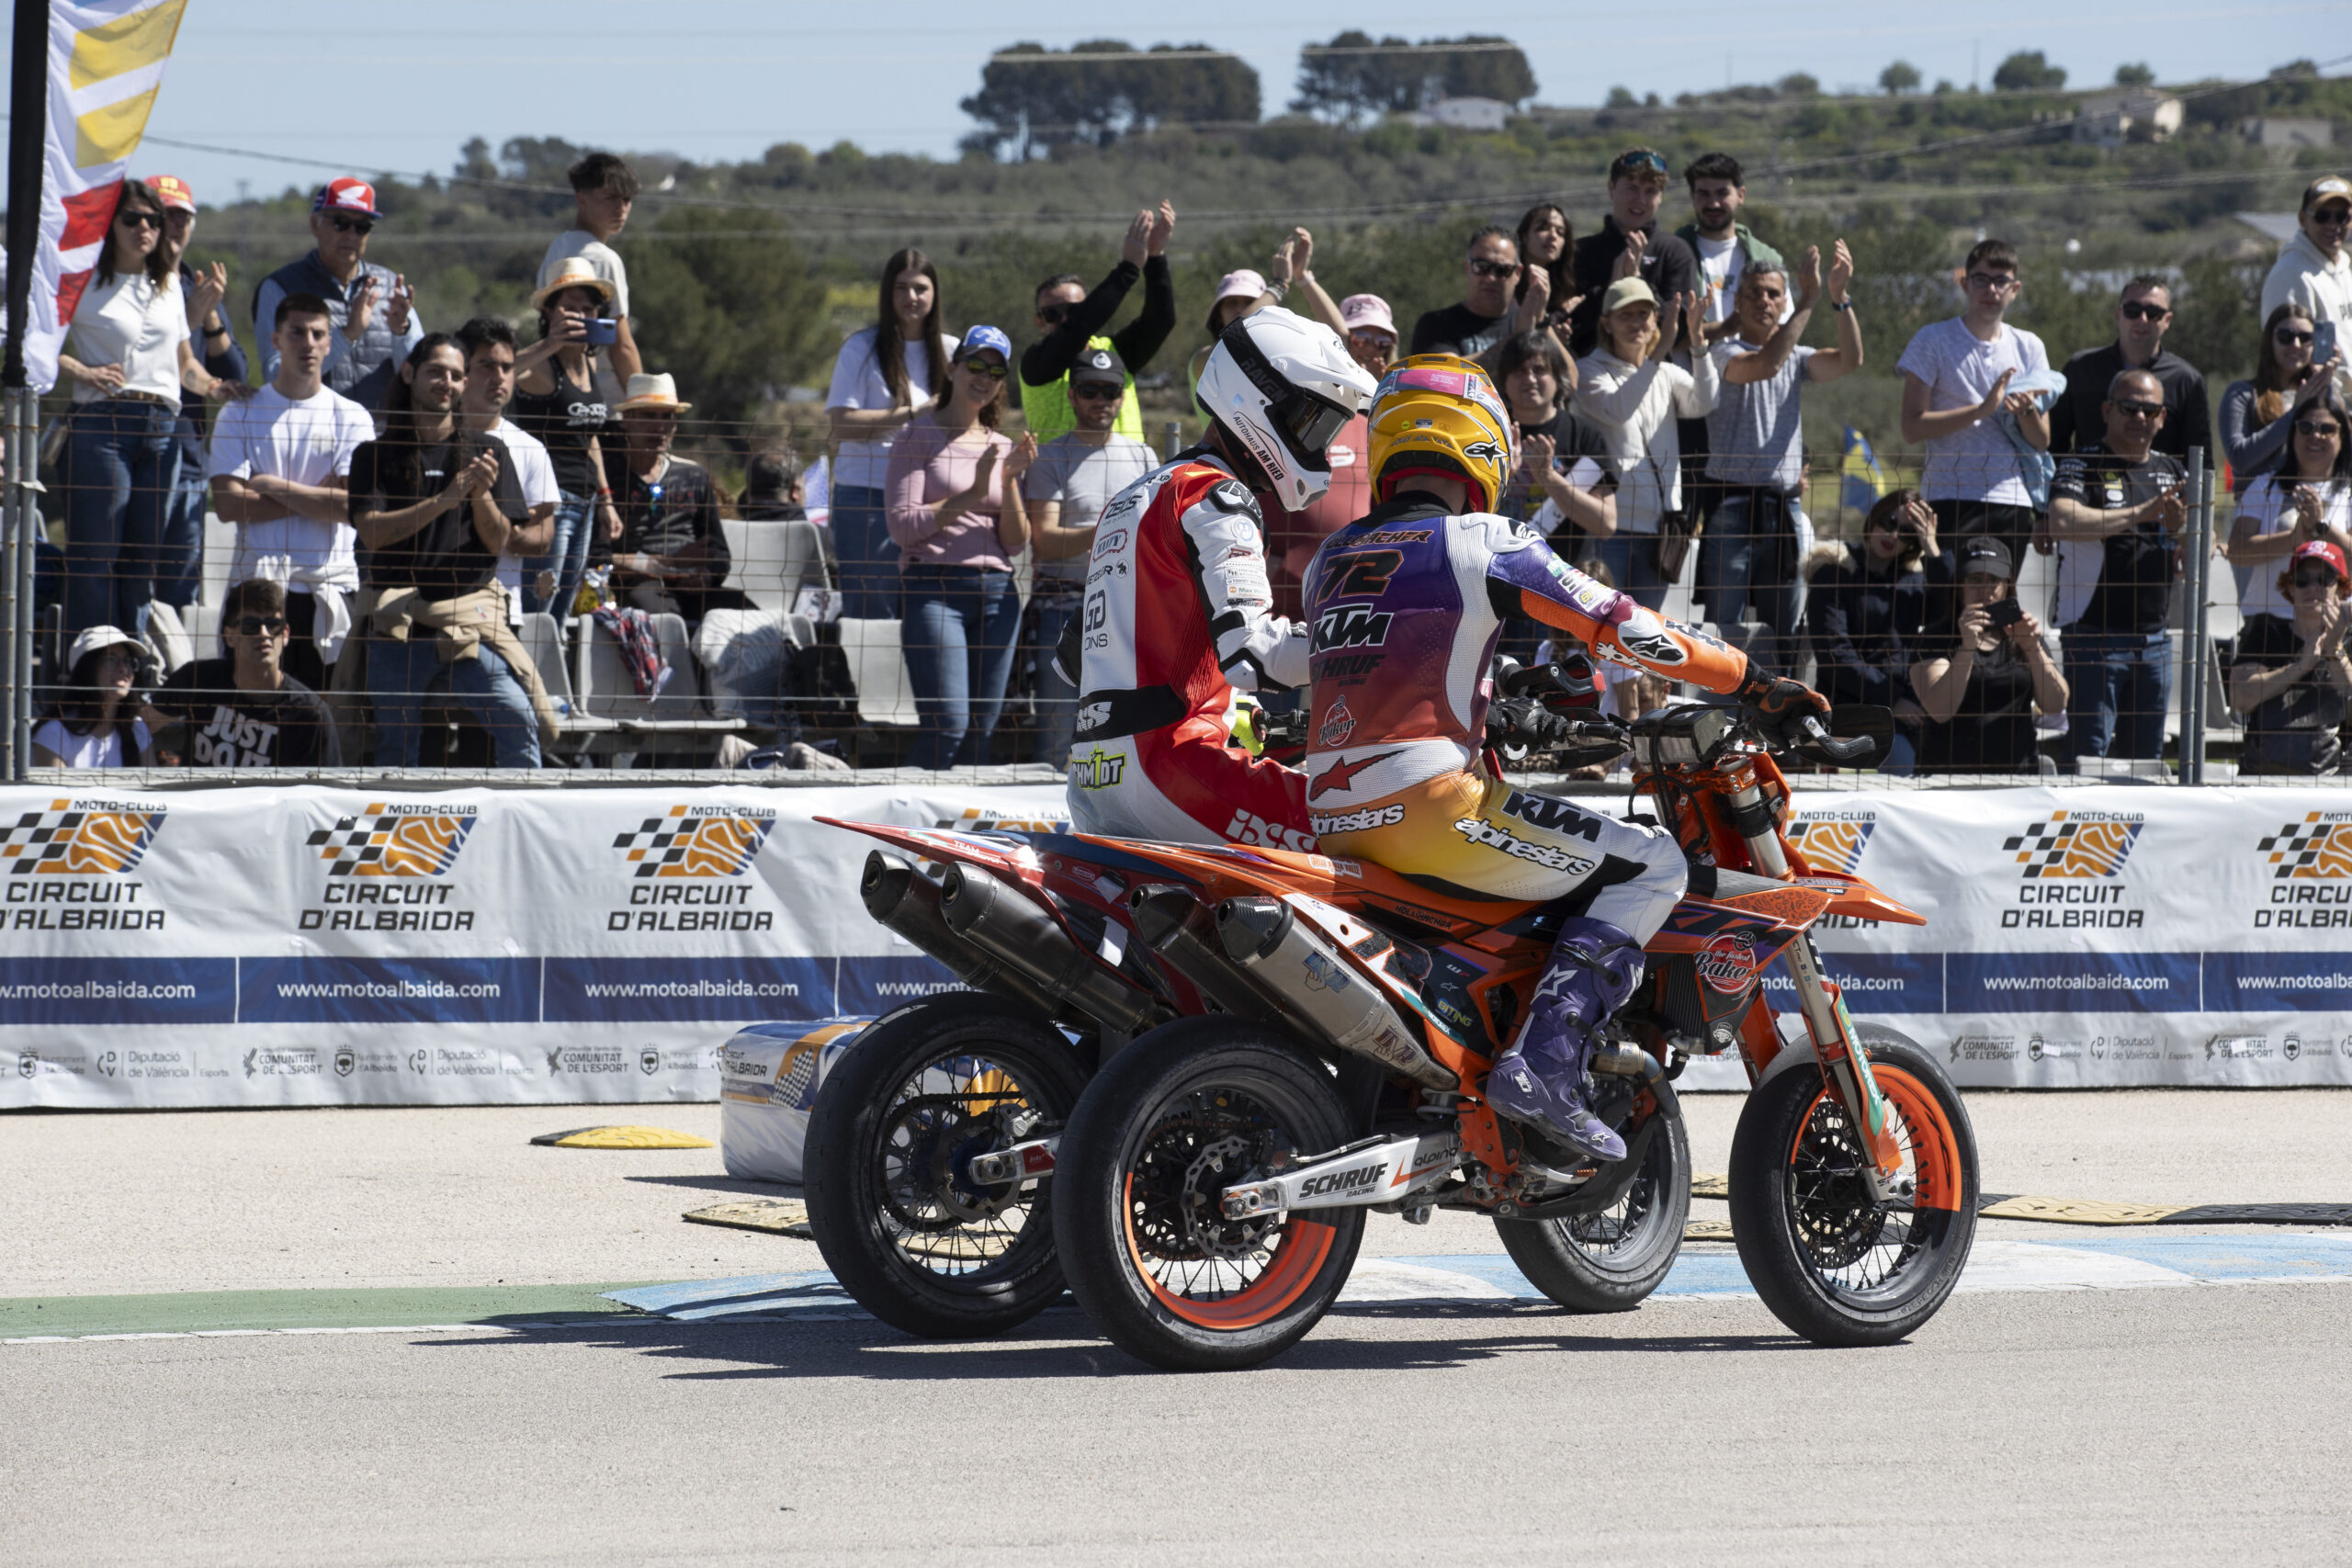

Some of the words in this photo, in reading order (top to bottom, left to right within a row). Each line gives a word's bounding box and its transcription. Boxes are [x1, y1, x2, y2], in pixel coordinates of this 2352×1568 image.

[1233, 416, 1260, 451] AUTOHAUS
[1256, 449, 1272, 464] AM
[1266, 461, 1284, 481] RIED
[1314, 549, 1404, 607] 72
[1308, 603, 1395, 658] KTM
[1664, 617, 1728, 654] KTM
[202, 705, 279, 756] JUST
[194, 731, 236, 767] DO
[74, 800, 168, 811] MOTO-CLUB
[388, 805, 478, 814] MOTO-CLUB
[691, 807, 776, 817] MOTO-CLUB
[1501, 790, 1602, 842] KTM
[1800, 811, 1876, 820] MOTO-CLUB
[2071, 812, 2144, 821] MOTO-CLUB
[1453, 816, 1596, 875] alpinestars
[6, 882, 142, 903] CIRCUIT
[323, 884, 454, 904] CIRCUIT
[629, 886, 752, 904] CIRCUIT
[2019, 886, 2125, 903] CIRCUIT
[0, 908, 165, 931] 'ALBAIDA
[299, 909, 474, 931] D'ALBAIDA
[607, 911, 773, 931] D'ALBAIDA
[2000, 909, 2144, 928] D'ALBAIDA
[277, 980, 501, 998] www.motoalbaida.com
[585, 979, 798, 998] www.motoalbaida.com
[1984, 974, 2169, 990] www.motoalbaida.com
[1962, 1041, 2014, 1051] COMUNITAT
[128, 1050, 181, 1064] Diputació
[562, 1053, 622, 1063] COMUNITAT
[1965, 1051, 1979, 1060] DE
[1981, 1051, 2019, 1060] L'ESPORT
[128, 1067, 142, 1077] de
[145, 1066, 189, 1078] València
[567, 1063, 582, 1074] DE
[583, 1063, 629, 1074] L'ESPORT
[1298, 1161, 1389, 1199] SCHRUF
[1346, 1185, 1376, 1198] RACING
